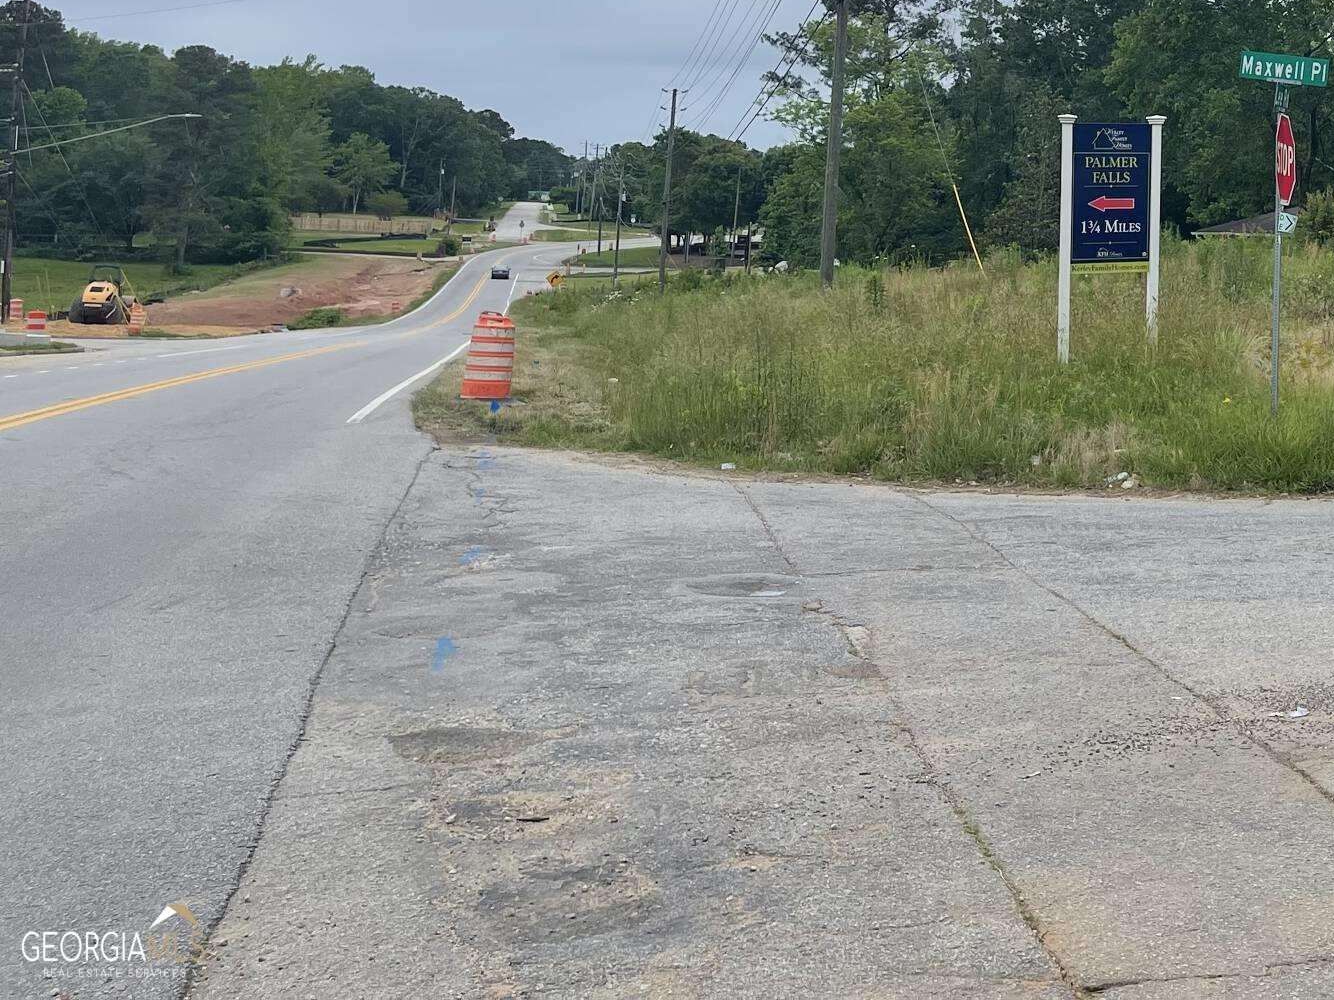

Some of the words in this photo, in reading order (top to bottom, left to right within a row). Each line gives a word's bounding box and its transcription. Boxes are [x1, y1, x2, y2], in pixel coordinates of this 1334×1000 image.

[1241, 55, 1305, 81] Maxwell
[1311, 62, 1327, 82] Pl
[1085, 156, 1138, 168] PALMER
[1277, 143, 1294, 177] STOP
[1093, 171, 1131, 183] FALLS
